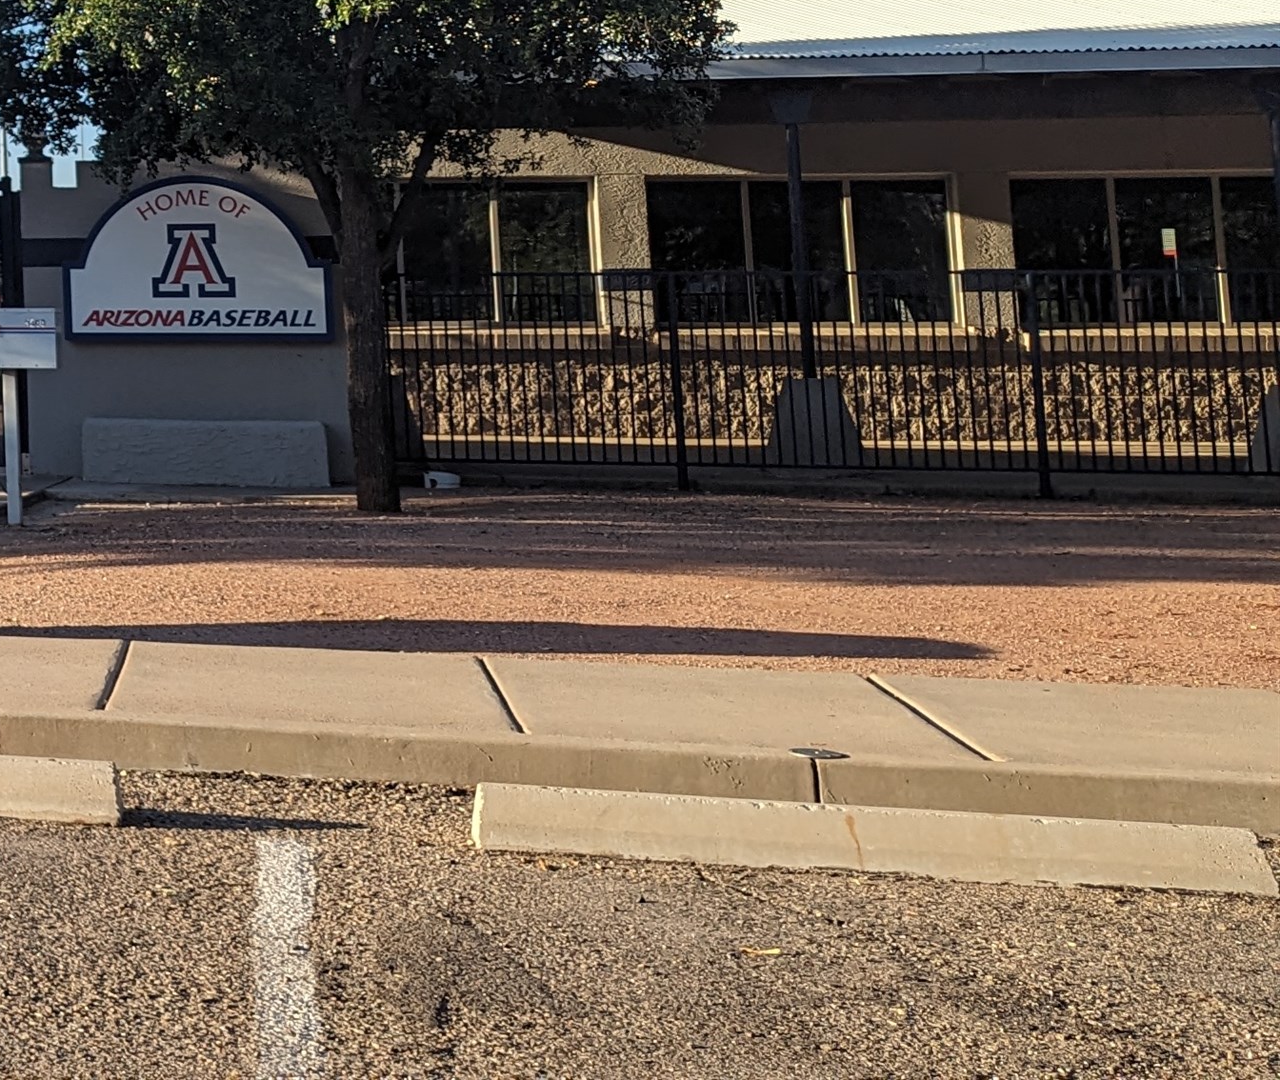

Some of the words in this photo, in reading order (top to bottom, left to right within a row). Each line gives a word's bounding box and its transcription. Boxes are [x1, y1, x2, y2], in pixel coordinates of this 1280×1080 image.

[136, 189, 210, 221] HOME
[219, 196, 251, 219] OF
[152, 223, 236, 298] A
